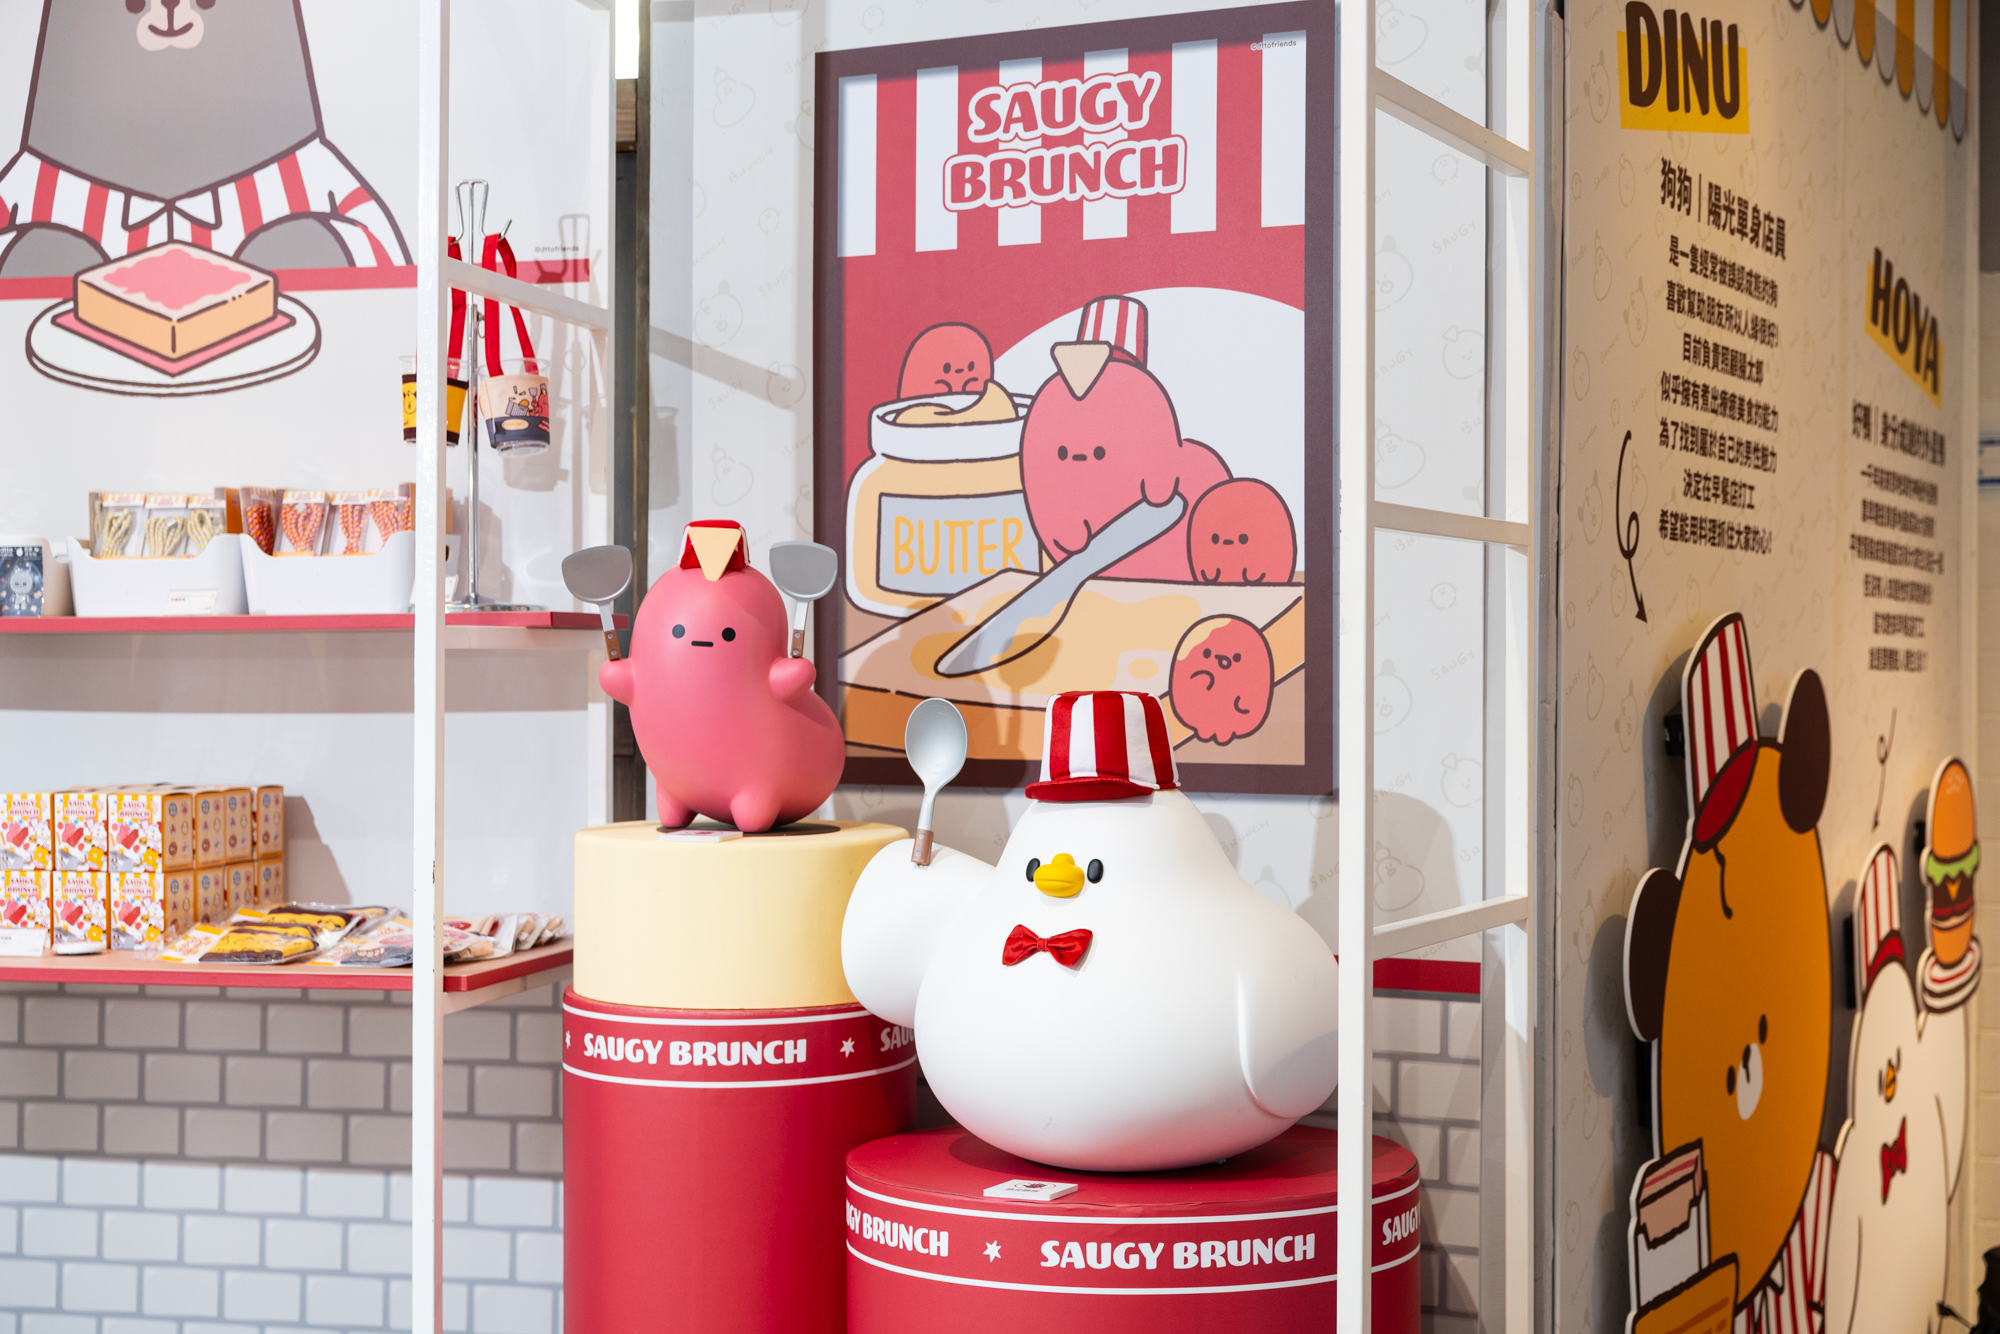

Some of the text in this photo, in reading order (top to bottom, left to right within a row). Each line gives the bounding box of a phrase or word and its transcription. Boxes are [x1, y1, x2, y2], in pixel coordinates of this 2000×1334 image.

[1625, 1, 1741, 120] DINU
[973, 77, 1155, 136] SAUGY
[950, 143, 1179, 203] BRUNCH
[1870, 247, 1938, 395] HOYA
[1683, 468, 1755, 510] 決定在早餐店打工
[893, 516, 1023, 576] BUTTER
[1310, 862, 1339, 889] SAUG
[583, 1032, 807, 1067] SAUGY BRUNCH
[880, 1026, 914, 1052] SAU
[862, 1213, 949, 1257] BRUNCH
[1041, 1233, 1316, 1270] SAUGY BRUNCH
